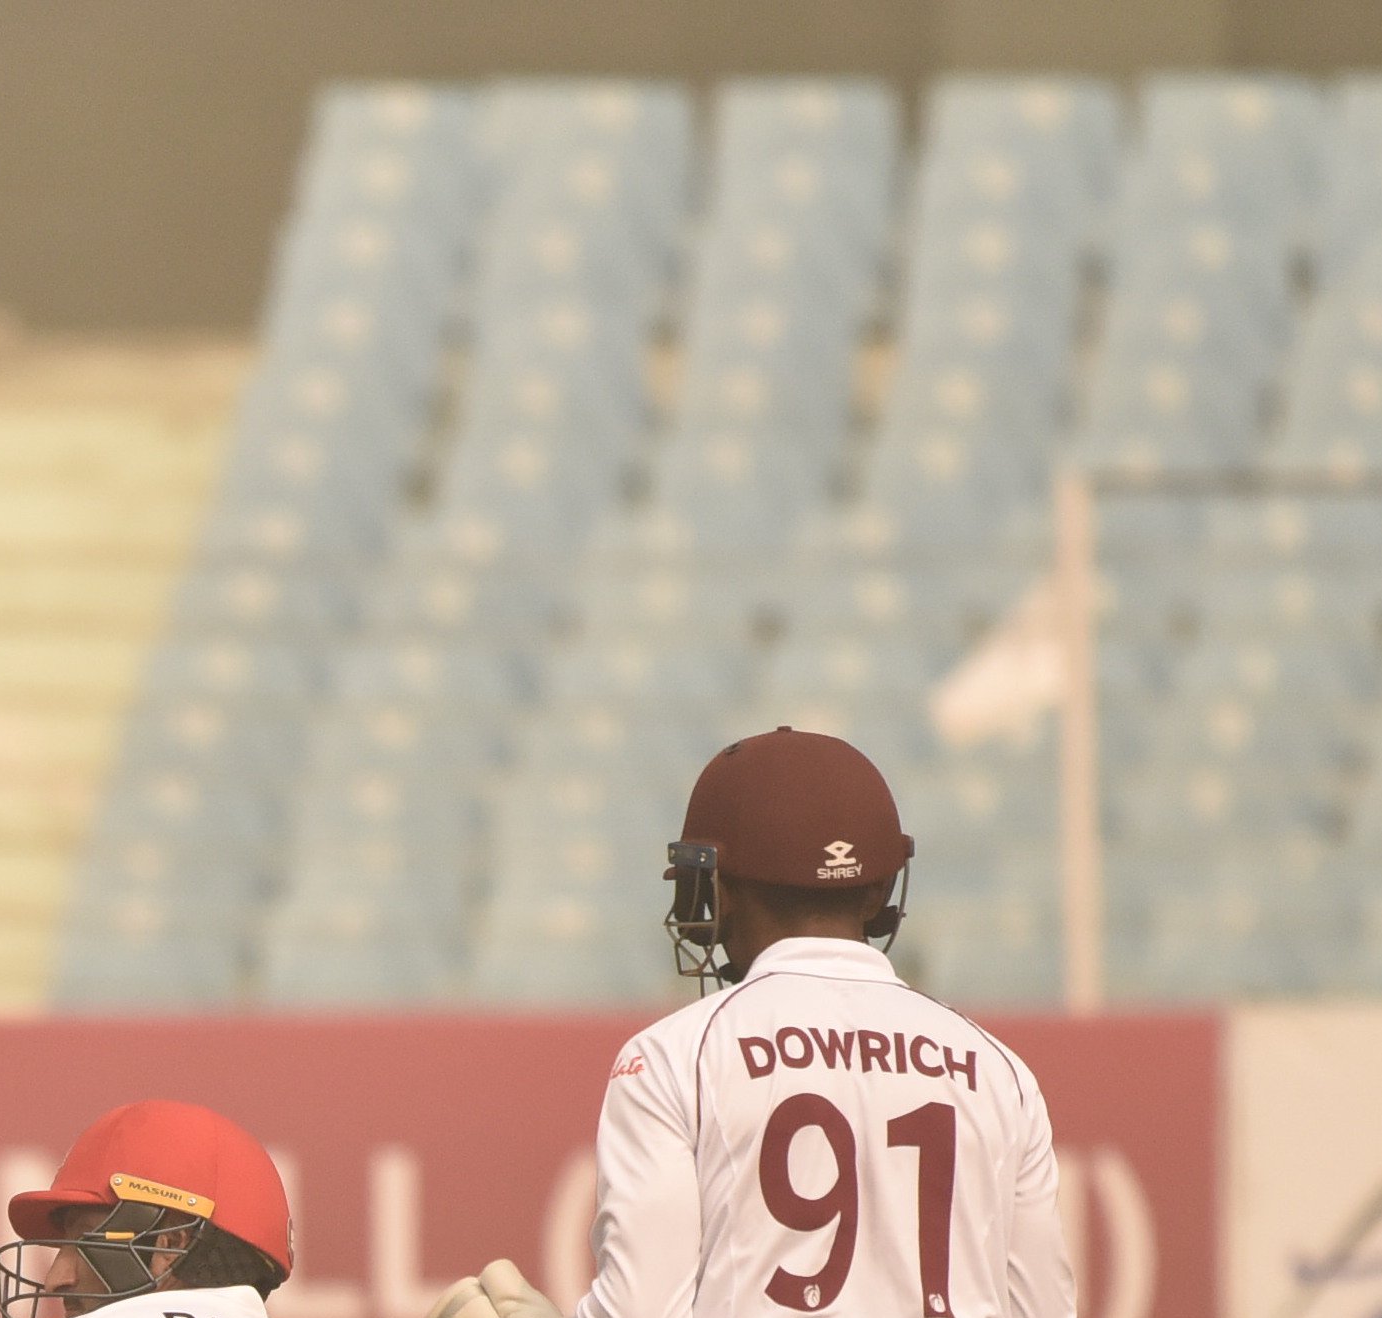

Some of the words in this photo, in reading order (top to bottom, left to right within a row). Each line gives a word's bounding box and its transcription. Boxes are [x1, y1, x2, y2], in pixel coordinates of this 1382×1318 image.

[817, 863, 863, 880] SHREY
[737, 1026, 977, 1093] DOWRICH
[129, 1181, 183, 1202] MASURI
